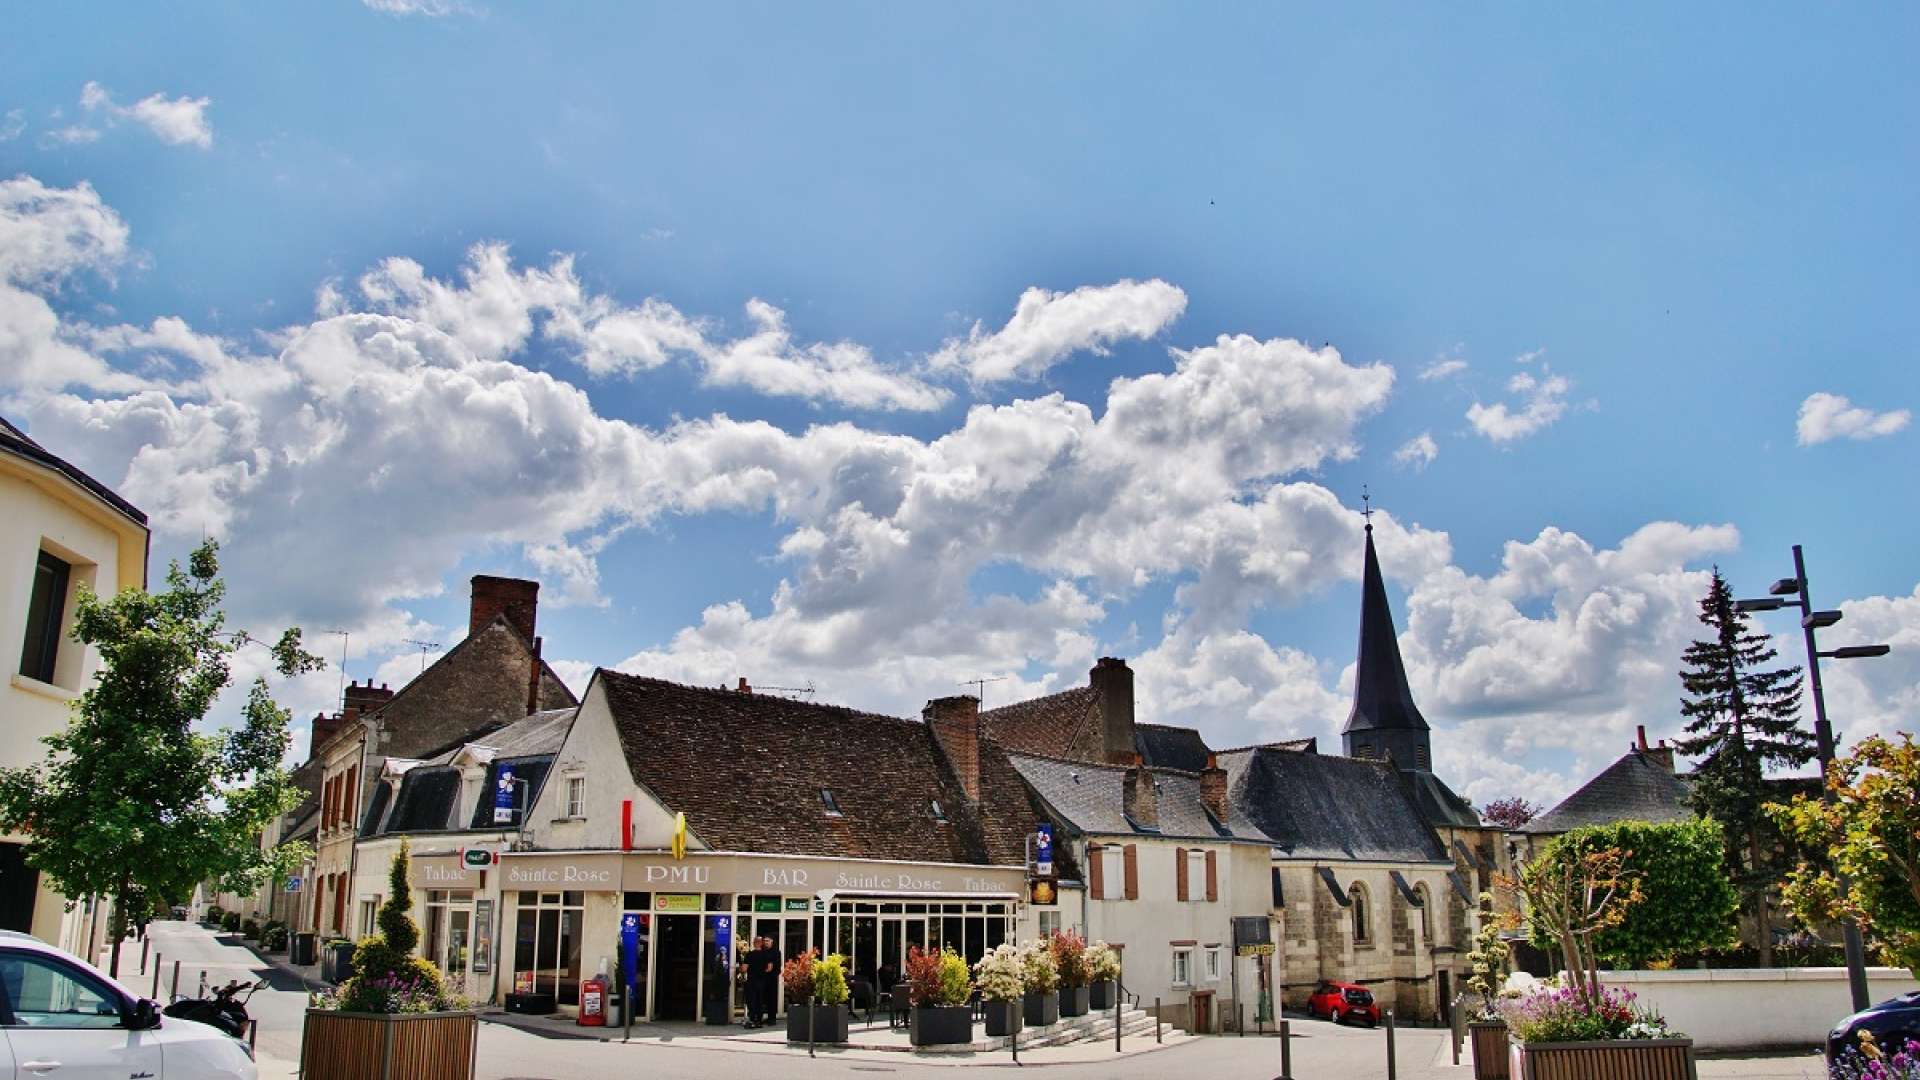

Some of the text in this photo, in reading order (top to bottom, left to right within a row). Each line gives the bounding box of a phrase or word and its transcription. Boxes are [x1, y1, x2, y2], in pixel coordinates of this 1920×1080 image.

[424, 864, 465, 880] Tabac
[508, 865, 609, 881] Sainte Rose
[645, 865, 711, 883] PMU
[763, 868, 808, 886] BAR
[836, 872, 942, 890] Sainte Rose
[962, 876, 1007, 891] Tabac
